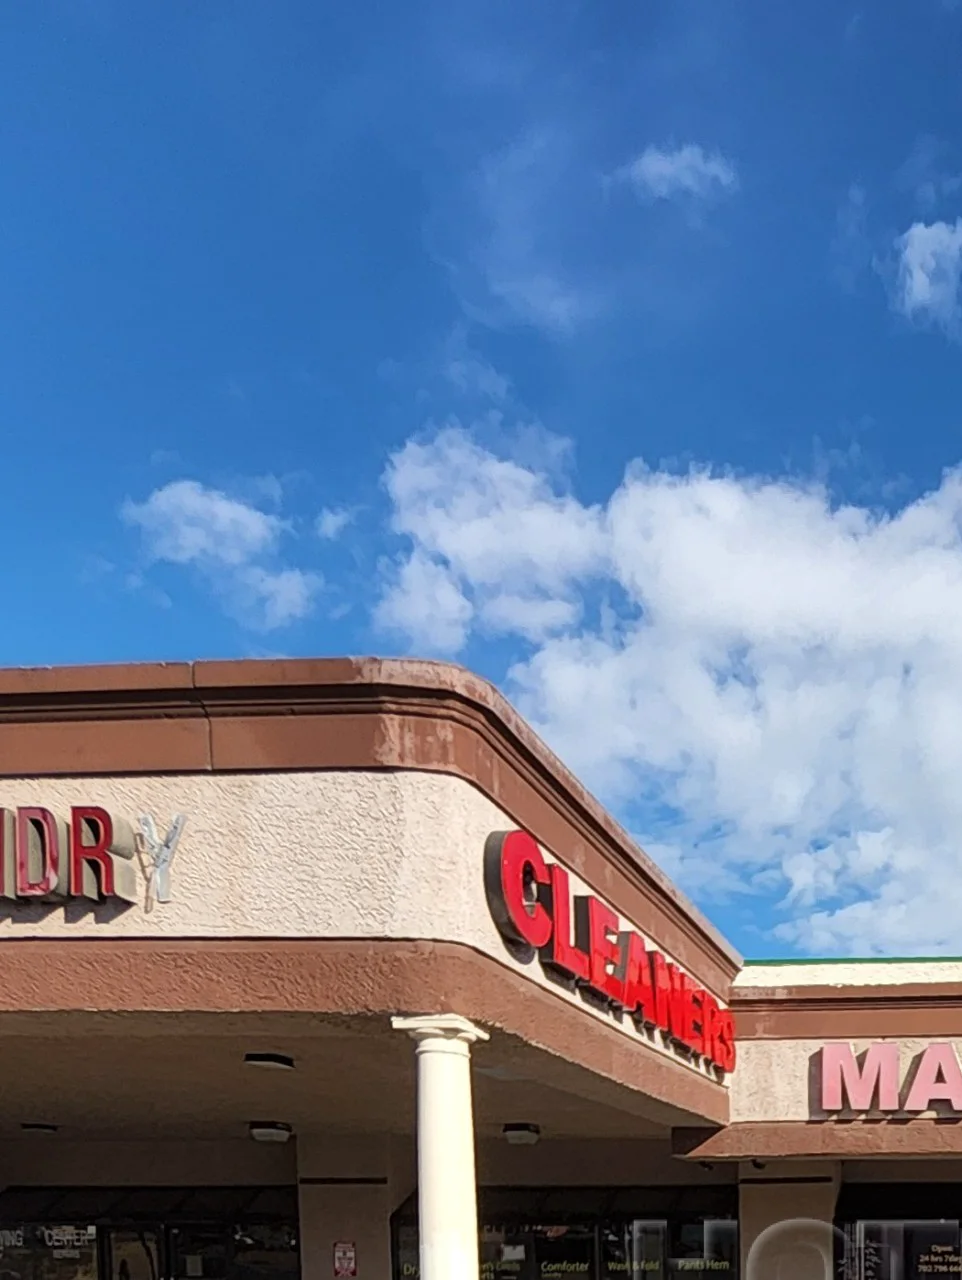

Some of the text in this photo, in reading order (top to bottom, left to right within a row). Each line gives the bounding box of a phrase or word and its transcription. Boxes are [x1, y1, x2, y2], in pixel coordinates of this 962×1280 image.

[484, 829, 737, 1075] CLEANERS
[541, 1259, 590, 1275] Comforter
[678, 1260, 730, 1271] Pants Hem
